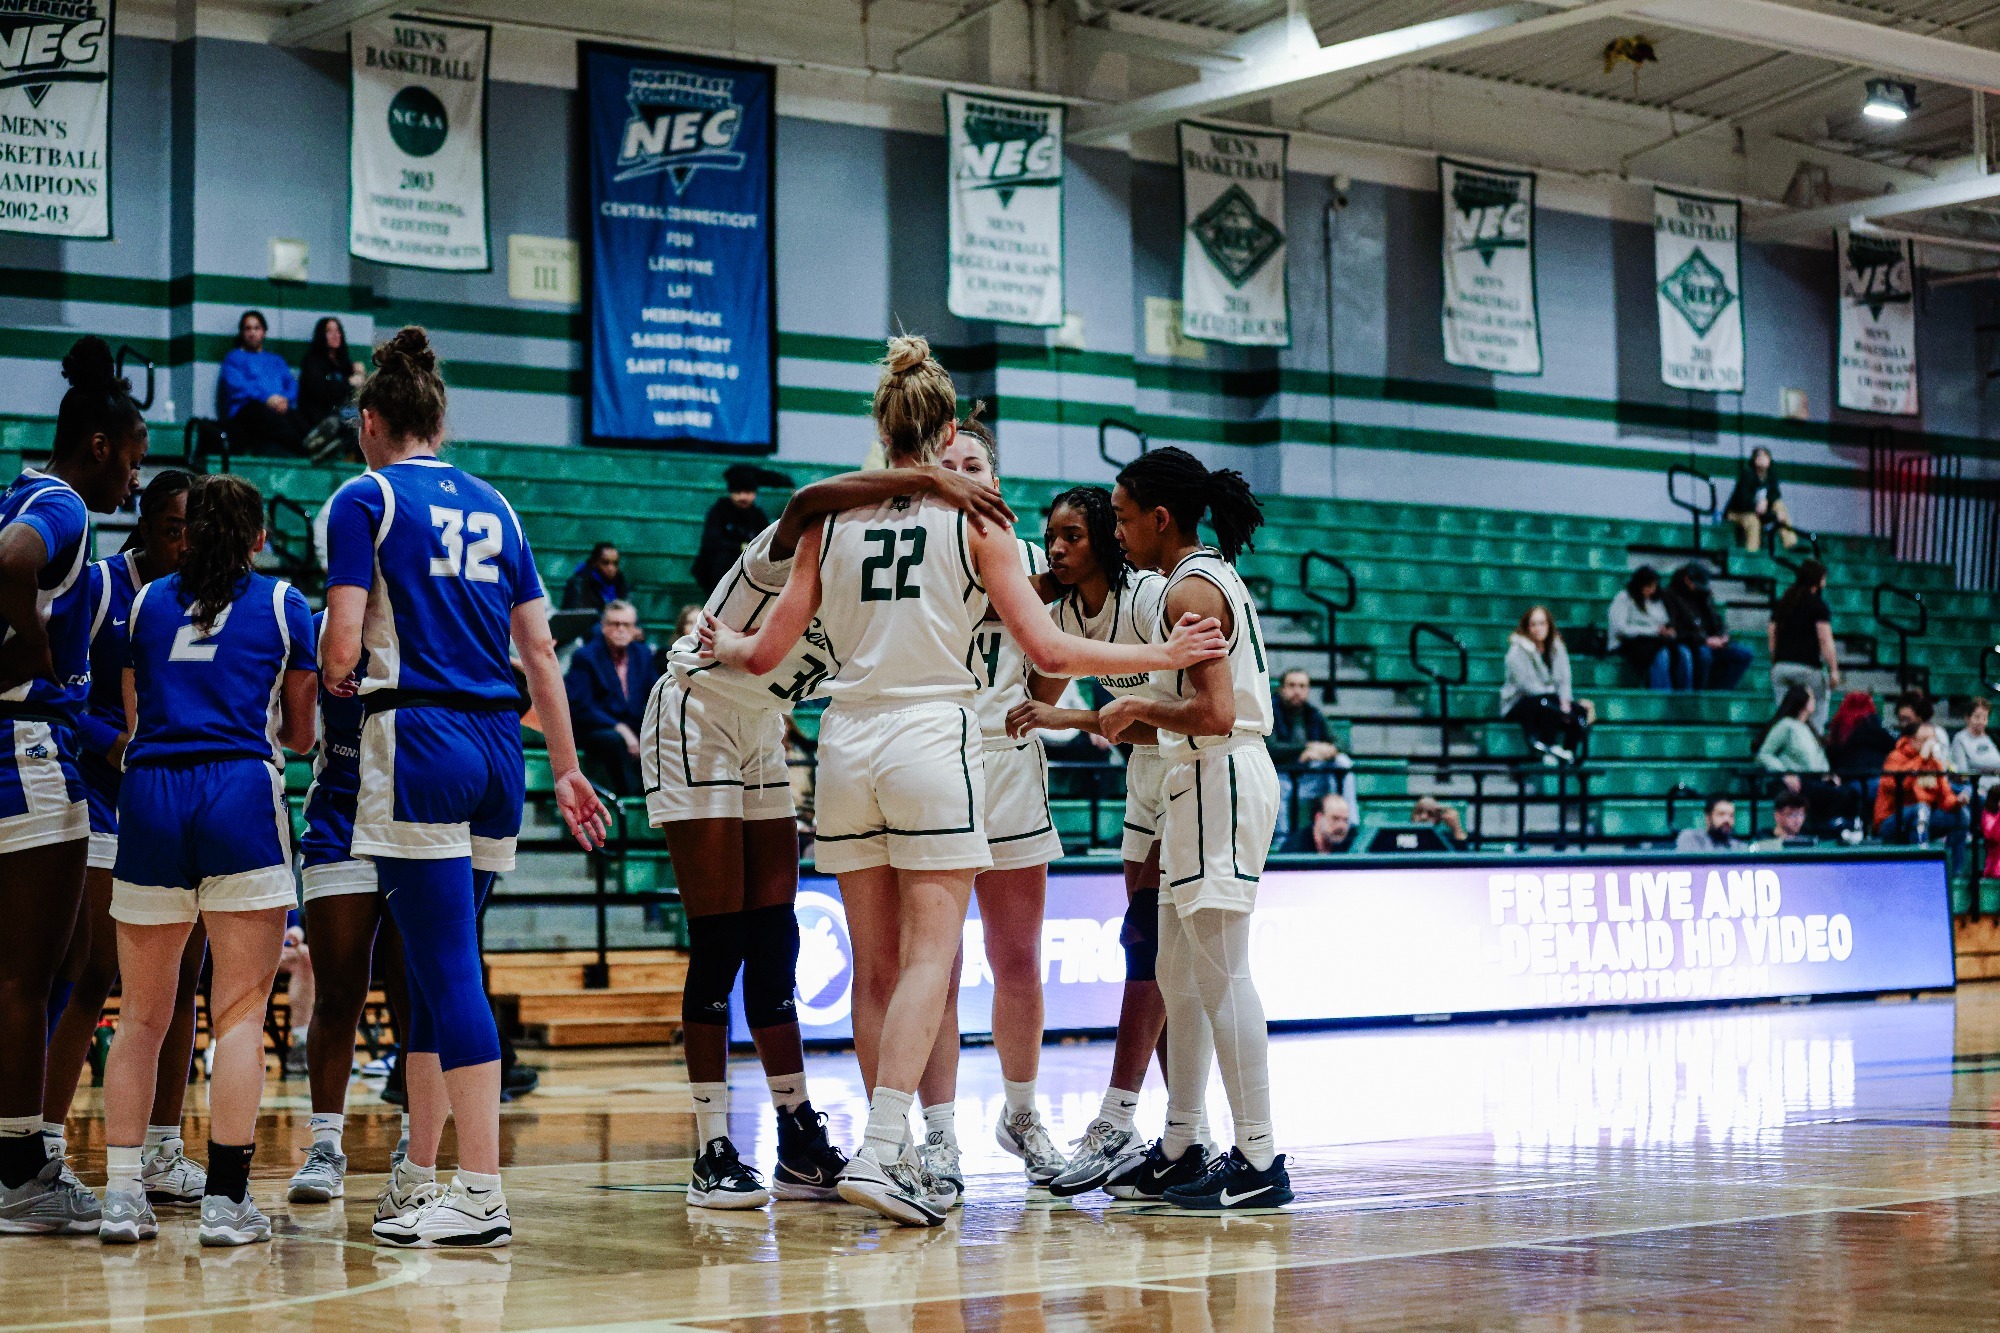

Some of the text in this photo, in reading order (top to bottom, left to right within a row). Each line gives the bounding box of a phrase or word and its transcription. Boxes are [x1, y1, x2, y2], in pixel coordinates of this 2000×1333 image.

[0, 0, 96, 19] NFERENCE
[0, 19, 105, 69] NEC
[393, 26, 448, 52] MEN'S
[365, 46, 475, 82] BASKETBALL
[1, 115, 68, 140] MEN'S
[390, 110, 443, 131] NCAA
[620, 107, 740, 160] NEC
[962, 136, 1055, 178] NEC
[0, 201, 69, 224] 2002-03
[601, 202, 666, 221] CENTRAL
[1453, 203, 1526, 245] NEC
[626, 357, 666, 375] SAINT
[429, 504, 503, 583] 32
[861, 526, 927, 602] 22
[168, 599, 233, 661] 2
[1243, 602, 1266, 674] 1
[1488, 869, 1781, 926] FREE LIVE AND
[1682, 917, 1737, 968] HD
[1742, 913, 1854, 965] VIDEO
